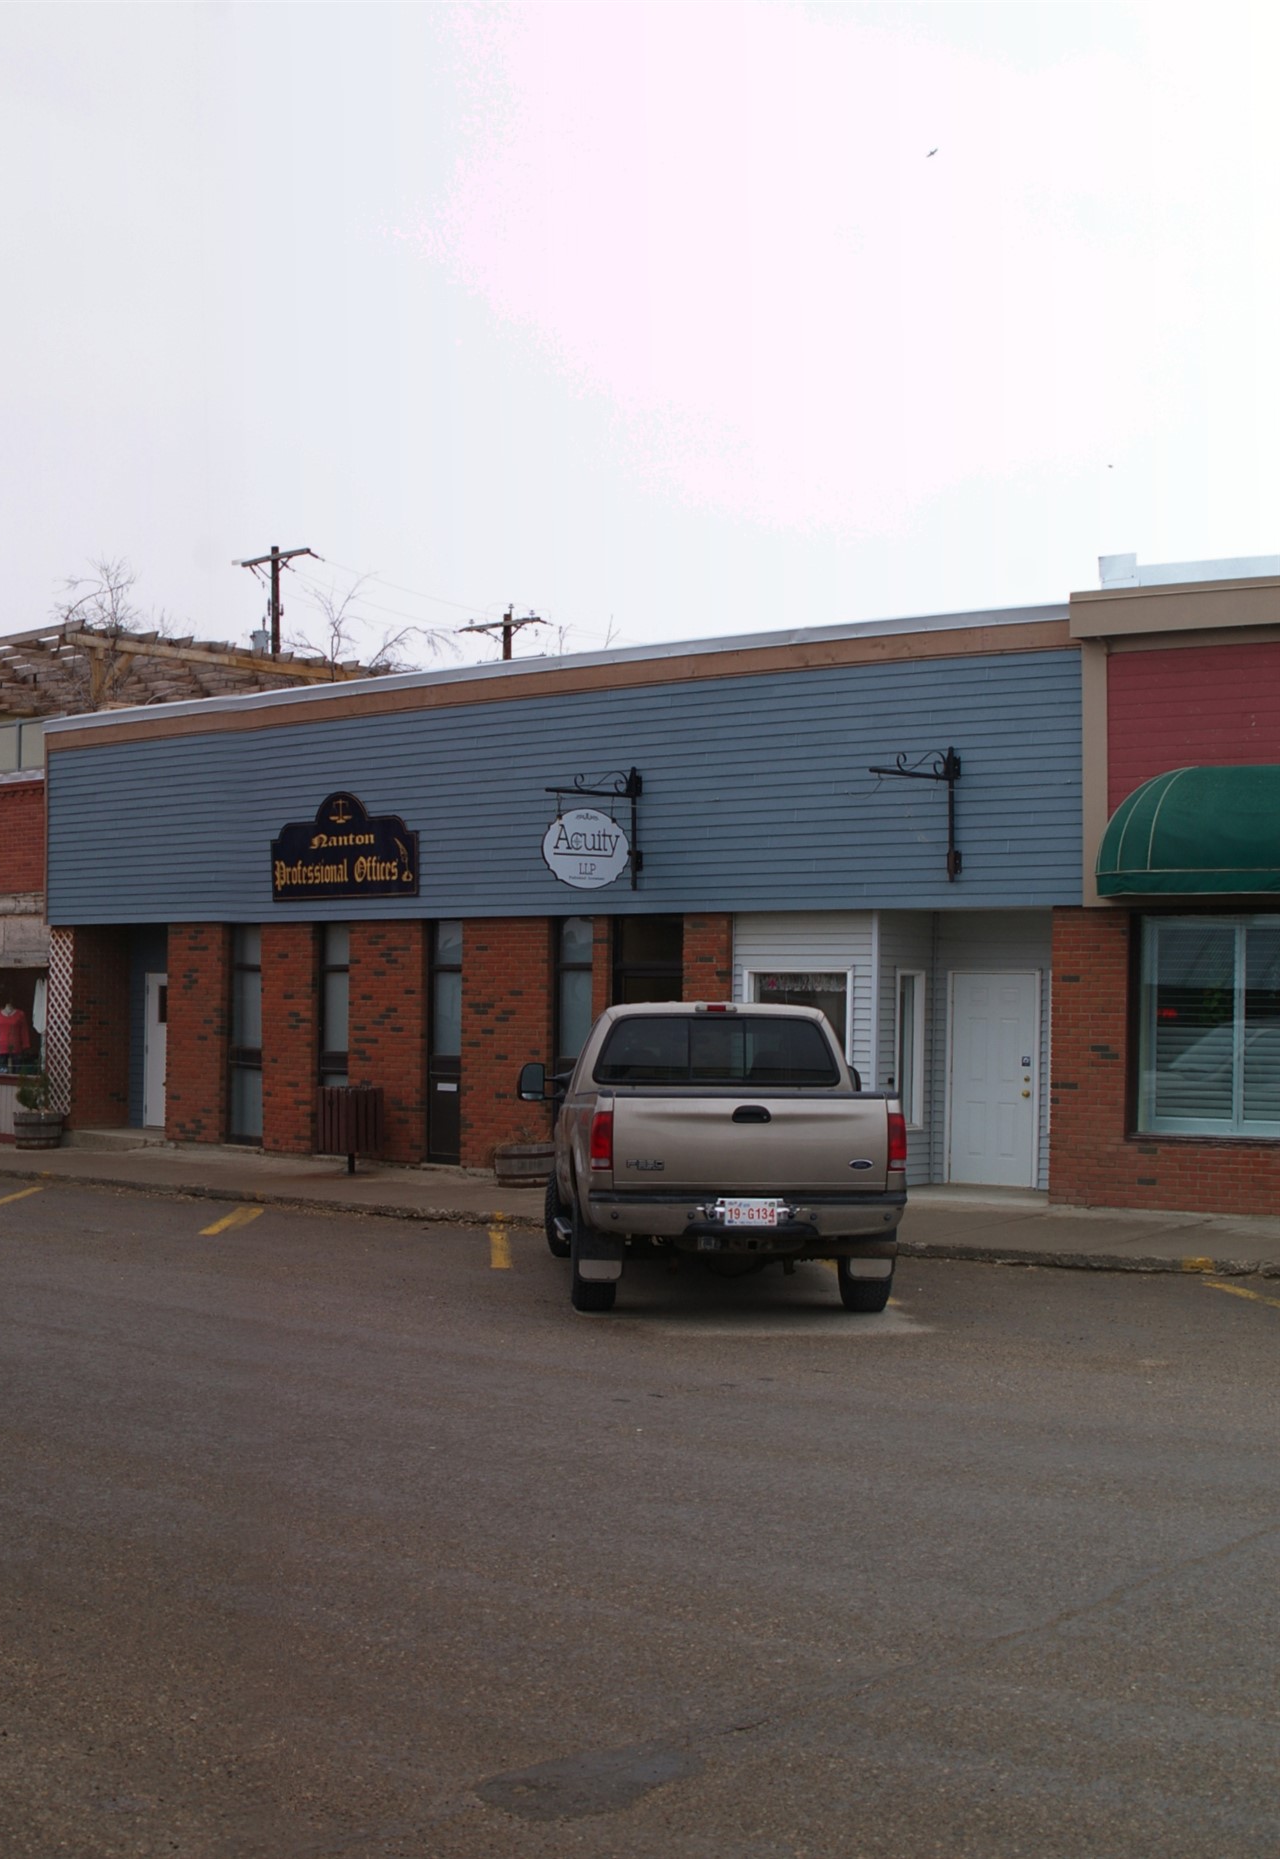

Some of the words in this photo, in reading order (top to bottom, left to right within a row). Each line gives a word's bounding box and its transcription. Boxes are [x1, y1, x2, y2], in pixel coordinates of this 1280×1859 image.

[309, 833, 375, 849] Nanton
[553, 824, 620, 858] Acuity
[275, 858, 348, 891] Professional
[354, 856, 399, 883] Offices
[578, 863, 597, 875] LLP
